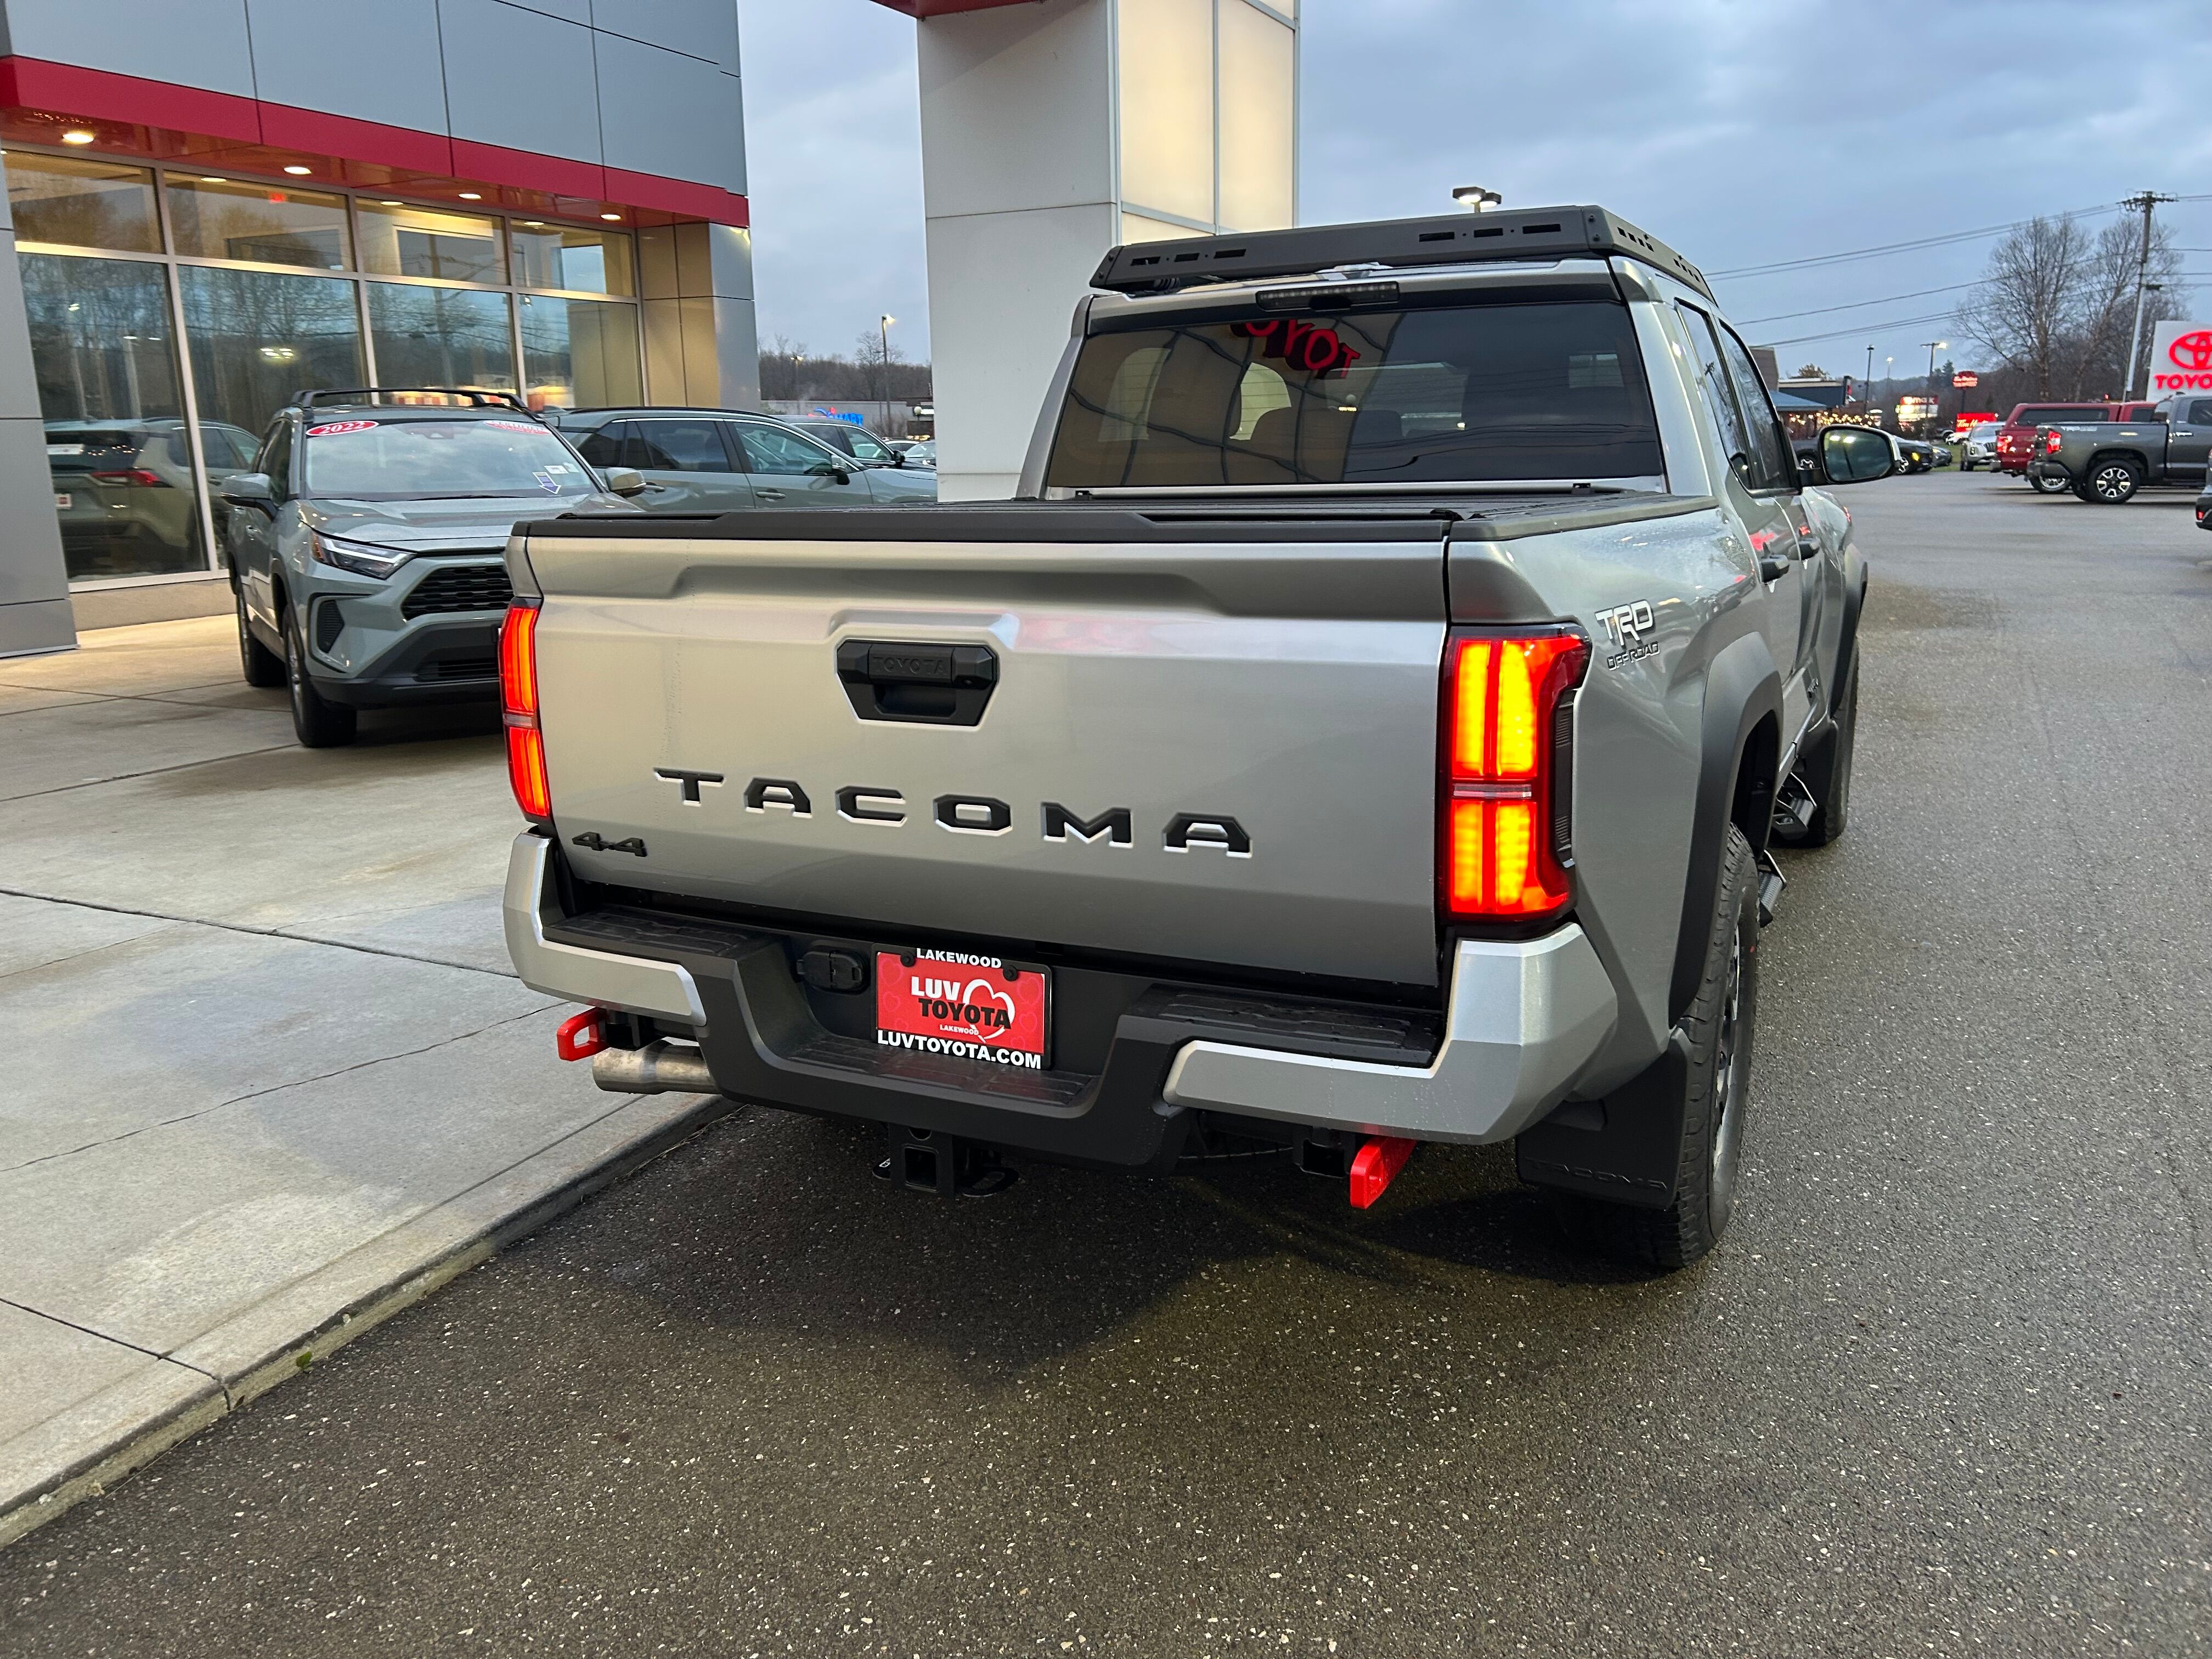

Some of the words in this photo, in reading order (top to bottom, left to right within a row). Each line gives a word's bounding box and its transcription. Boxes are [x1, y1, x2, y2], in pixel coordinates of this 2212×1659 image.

[319, 421, 366, 435] 2022
[1594, 599, 1654, 646] TRD
[873, 656, 947, 676] TOYOTA
[1607, 653, 1629, 671] OFF
[1629, 641, 1660, 663] ROAD
[653, 768, 1253, 859] TACOMA
[916, 947, 1002, 968] LAKEWOOD
[911, 976, 961, 1001] LUV
[918, 997, 1012, 1029] TOYOTA
[939, 1024, 979, 1036] LAKEWOOD
[877, 1030, 1041, 1069] LUVTOYOTA.COM
